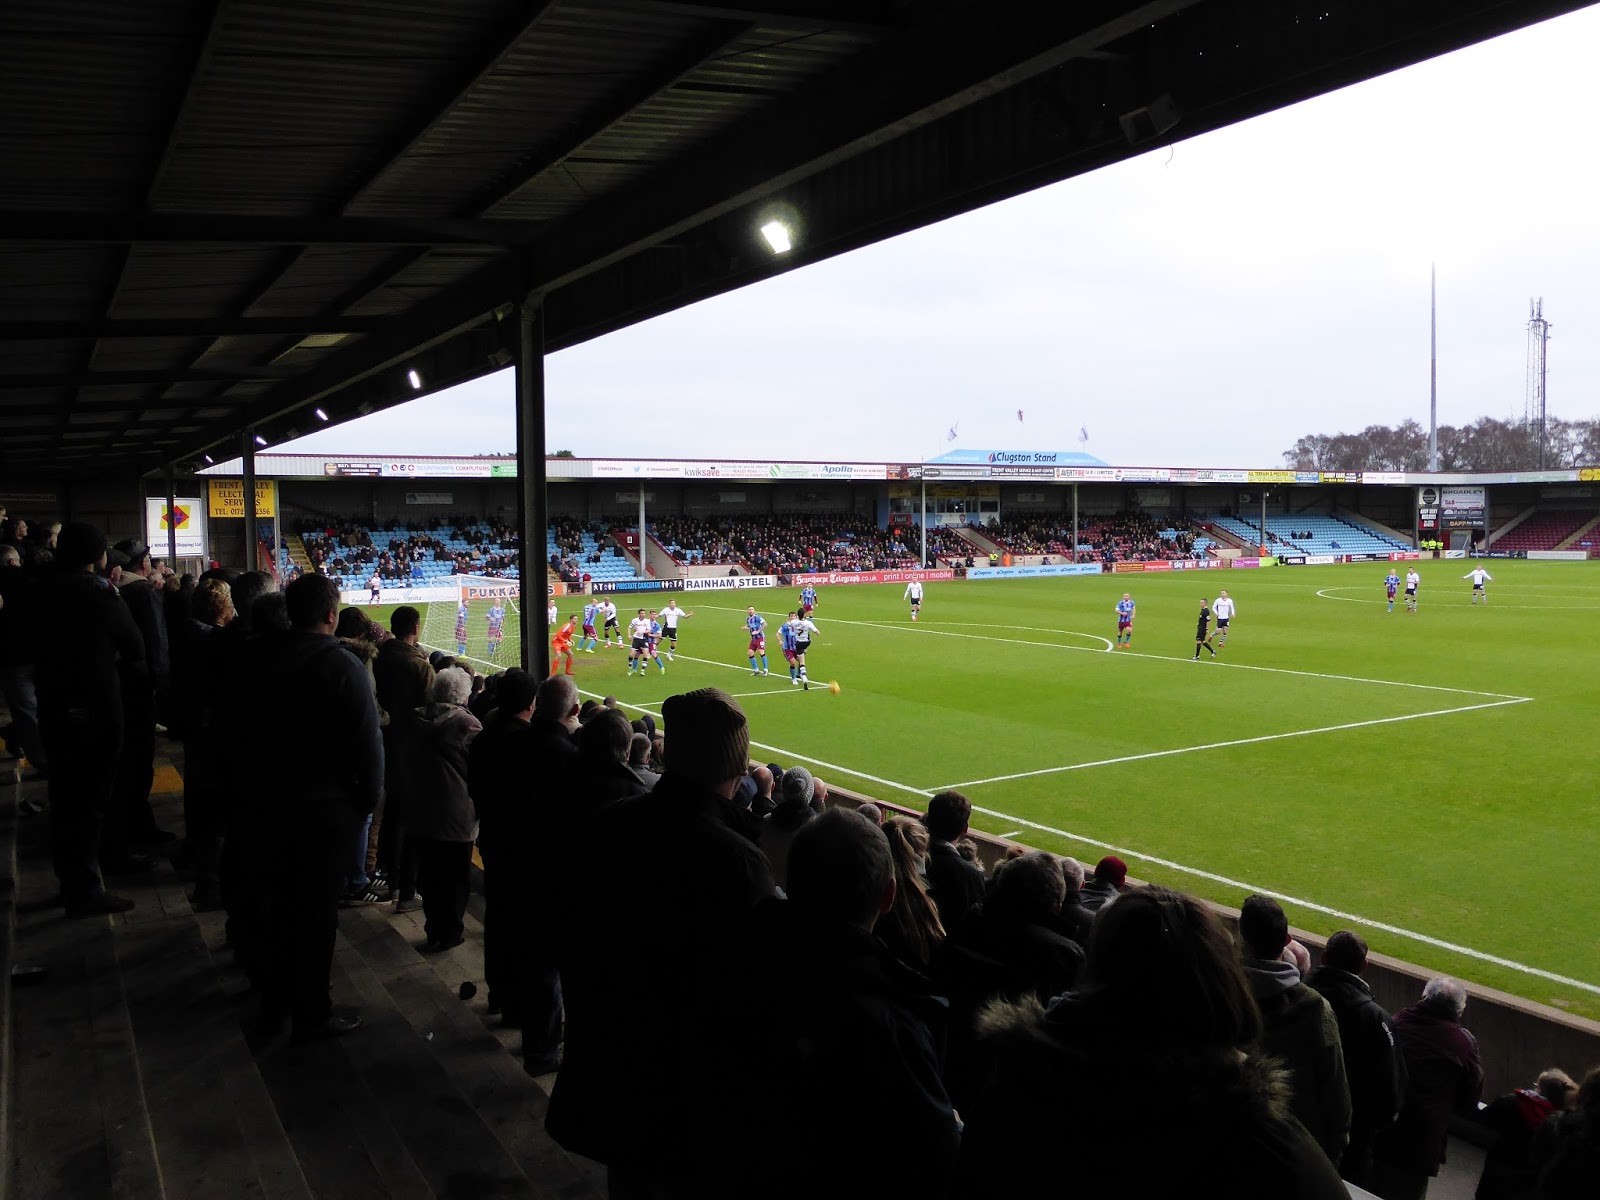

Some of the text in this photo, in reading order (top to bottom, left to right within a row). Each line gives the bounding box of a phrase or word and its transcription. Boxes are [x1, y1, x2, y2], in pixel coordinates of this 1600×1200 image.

[996, 452, 1031, 463] Clugston
[1034, 453, 1057, 462] Stand
[684, 467, 720, 477] kwiksave
[821, 465, 853, 473] Apollo
[214, 481, 270, 489] TRENT VLEY
[218, 490, 265, 498] ELECTAL
[224, 498, 261, 506] SERVS
[1174, 561, 1184, 569] sky
[1198, 560, 1208, 568] sky
[796, 575, 829, 585] Scunthorpe
[883, 573, 900, 581] print
[616, 582, 637, 590] PROSTATE
[686, 577, 771, 589] RAINHAM STEEL
